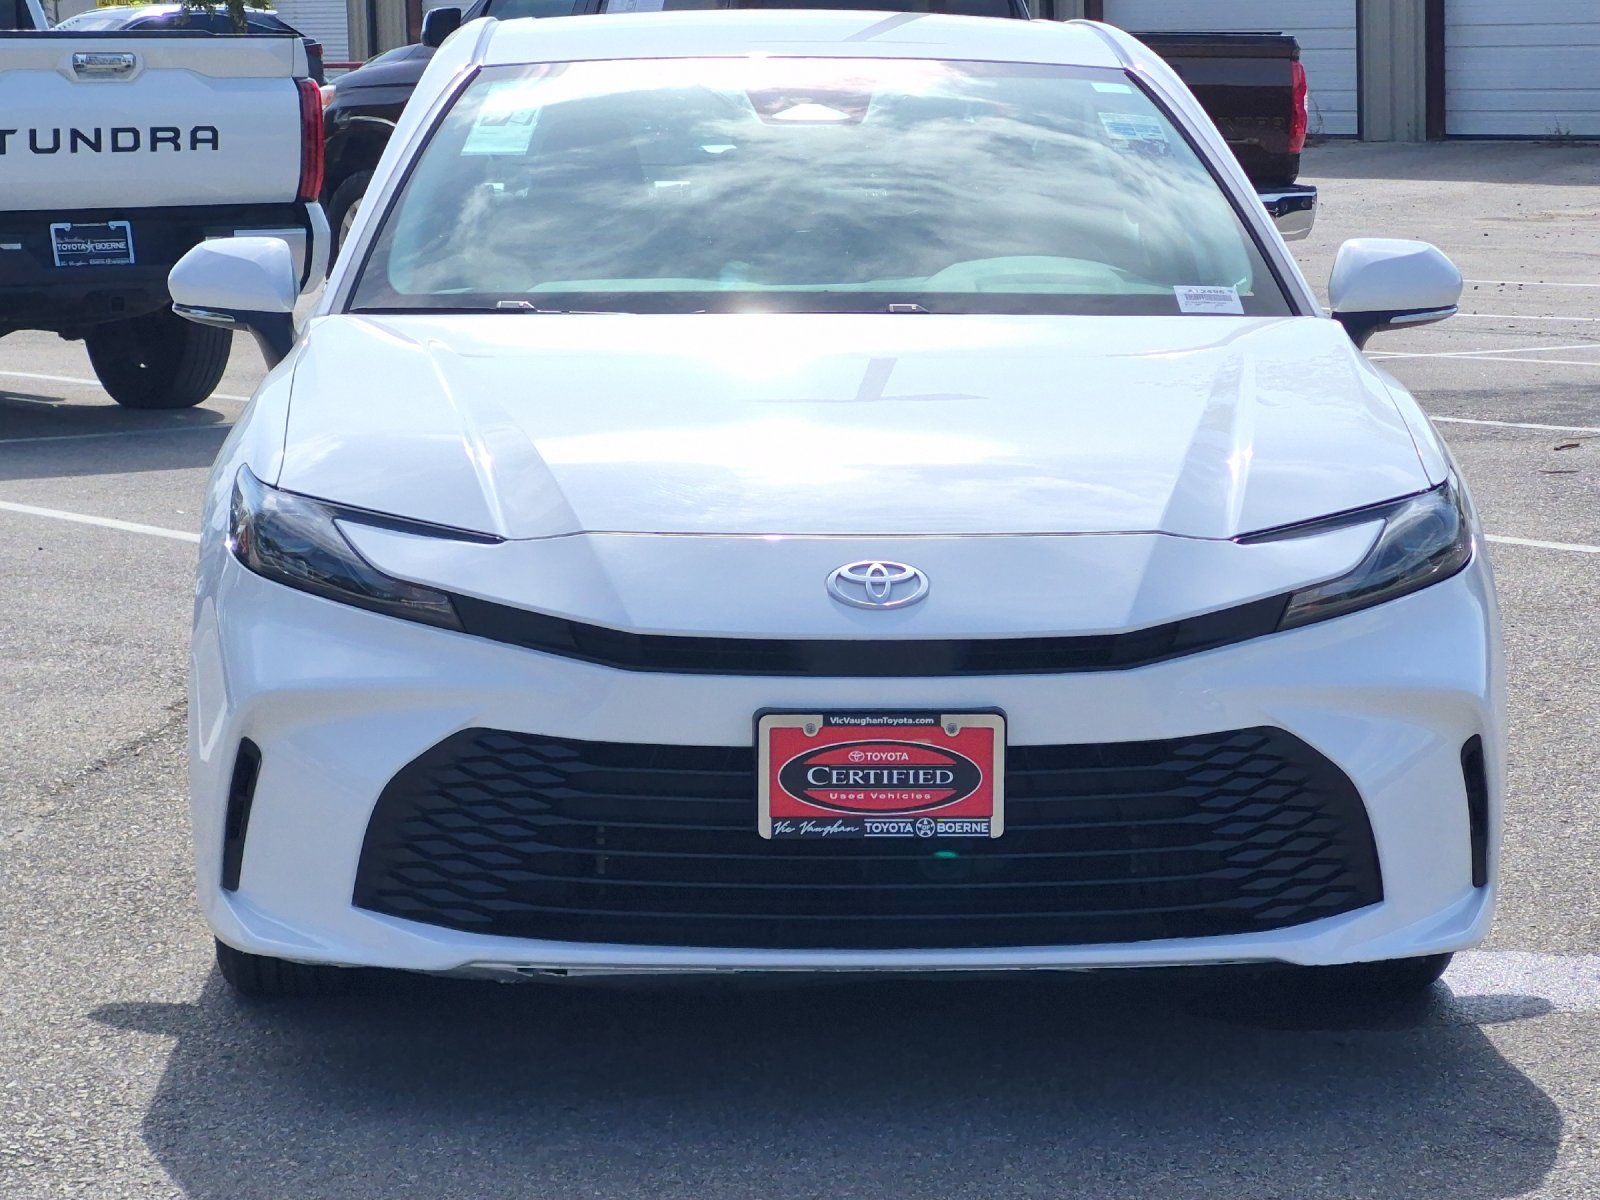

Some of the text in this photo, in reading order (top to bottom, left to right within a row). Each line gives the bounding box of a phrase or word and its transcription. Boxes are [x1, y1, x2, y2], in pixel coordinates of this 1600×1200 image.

[57, 241, 127, 251] TOYOTA BOERNE
[830, 716, 934, 726] VicVaughanToyota.com
[866, 752, 909, 761] TOYOTA
[807, 766, 954, 785] CERTIFIED
[829, 792, 931, 800] Used Vehicles
[773, 820, 796, 836] Vic
[799, 819, 859, 837] Vaughan
[864, 823, 914, 833] TOYOTA
[937, 822, 989, 833] BOERNE
